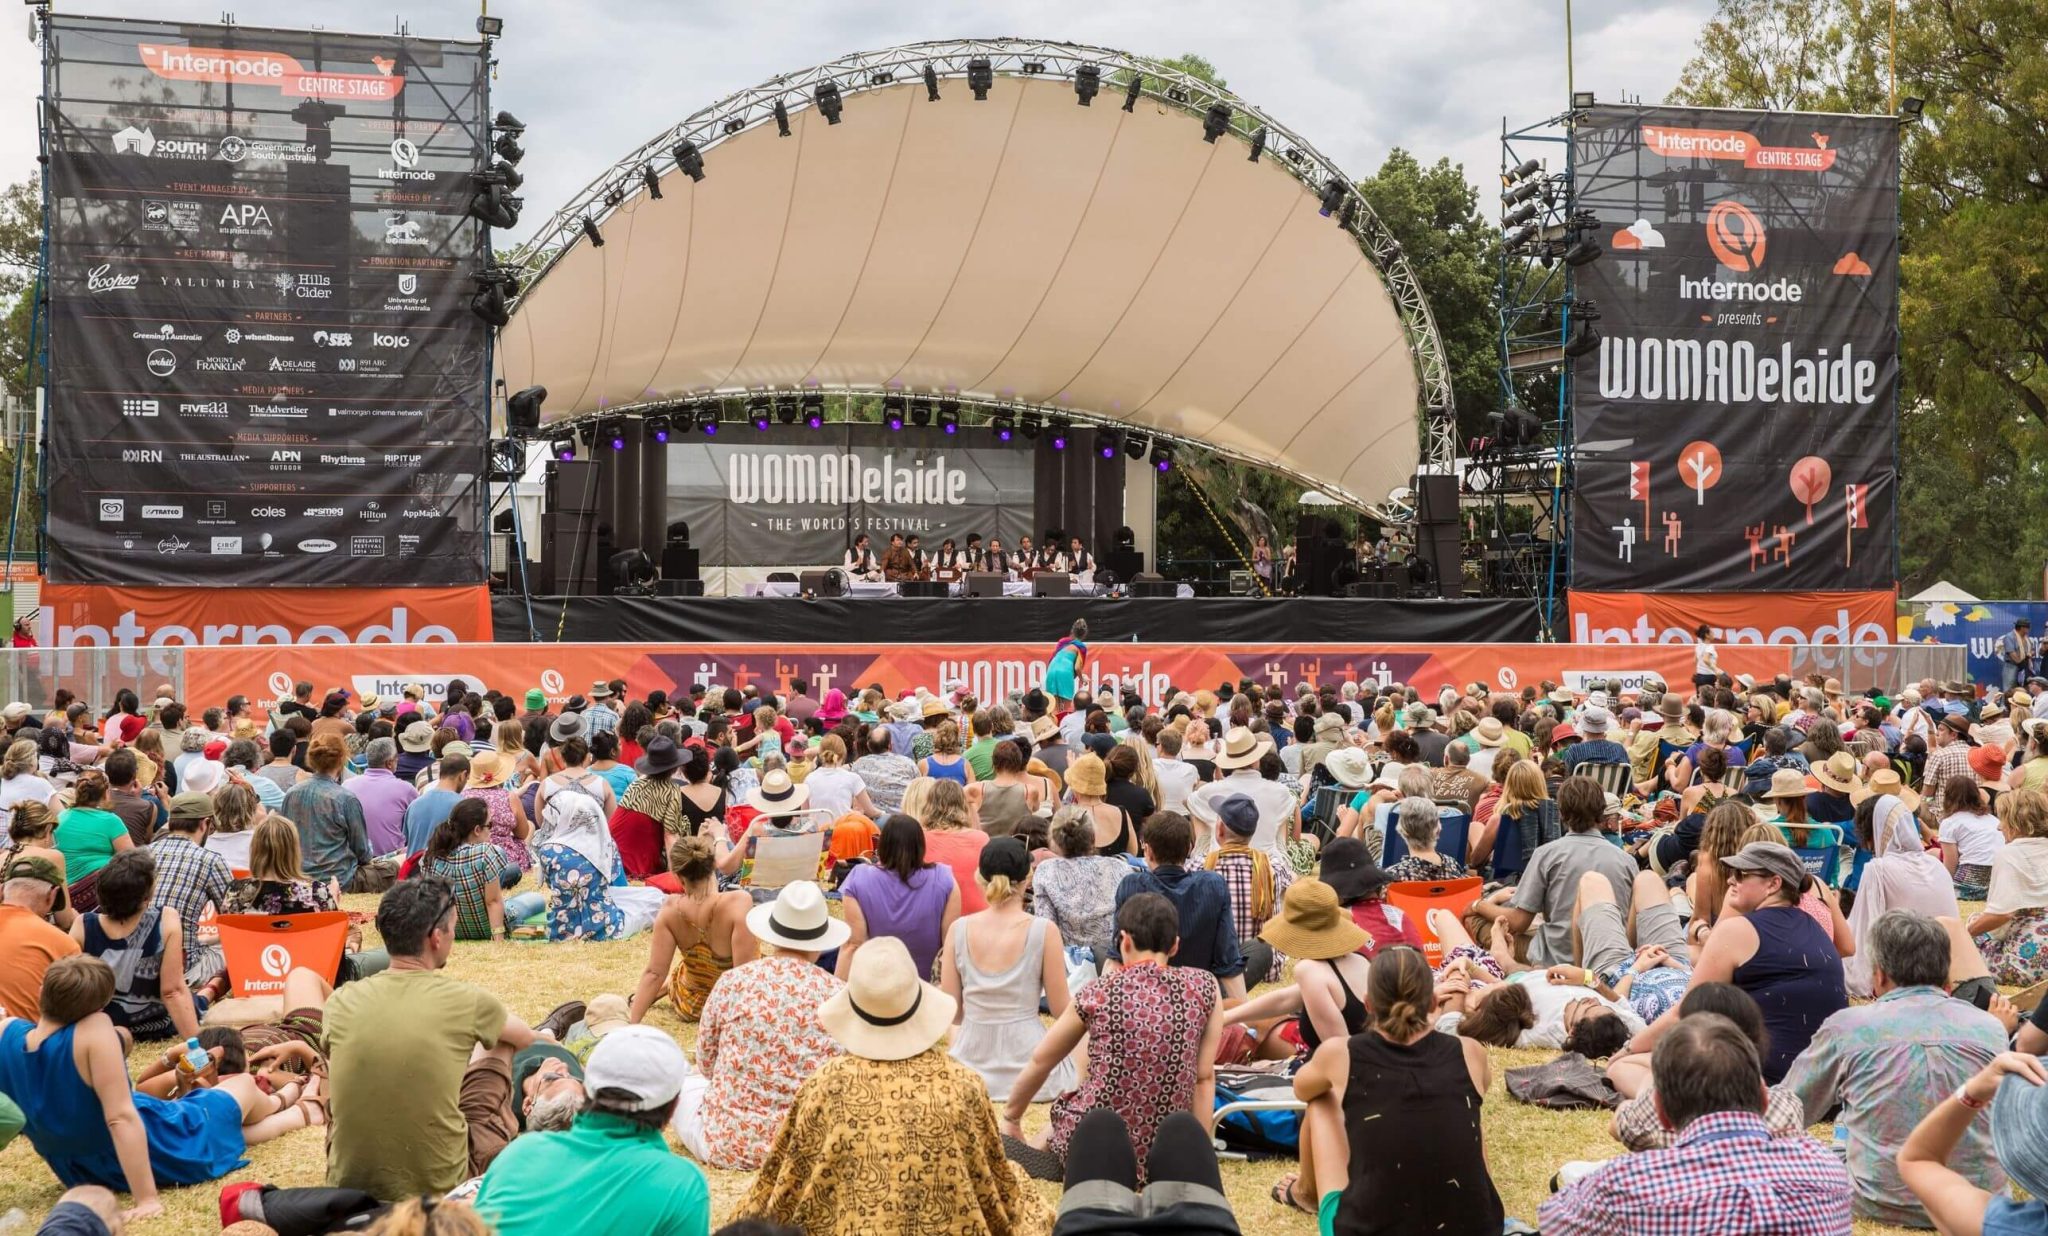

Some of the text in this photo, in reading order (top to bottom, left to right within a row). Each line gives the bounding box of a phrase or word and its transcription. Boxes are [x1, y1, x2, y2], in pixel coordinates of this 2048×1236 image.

[162, 50, 284, 78] Internode
[298, 76, 386, 96] CENTRE STAGE
[157, 140, 207, 155] SOUTH
[251, 142, 306, 154] Government
[307, 143, 317, 154] of
[1658, 131, 1746, 153] Internode
[157, 153, 207, 161] AUSTRALIA
[251, 151, 317, 163] South Australia
[1756, 150, 1823, 168] CENTRE STAGE
[378, 168, 436, 181] Internode
[174, 182, 248, 194] EVENT MANAGED BY
[382, 193, 432, 203] PRODUCED BY
[172, 202, 199, 210] WOMAD
[219, 203, 272, 227] APA
[184, 249, 198, 258] KEY
[370, 256, 409, 266] EDUCATION
[88, 264, 140, 293] Coopers
[161, 276, 255, 290] YALUMBA
[299, 274, 331, 286] Hills
[296, 287, 332, 299] Cider
[1680, 275, 1802, 302] Internode
[388, 297, 419, 305] University
[404, 304, 431, 312] Australia
[255, 312, 293, 321] PARTNERS
[1717, 312, 1762, 327] presents
[133, 332, 165, 341] Greening
[245, 334, 294, 342] wheelhouse
[196, 360, 242, 371] FRANKLIN
[268, 356, 316, 372] ADELAIDE
[373, 359, 387, 367] ABC
[1600, 336, 1876, 405] WOMADelaide
[242, 385, 305, 396] MEDIA PARTNERS
[142, 400, 159, 417] 9
[180, 402, 229, 414] FIVEaa
[249, 404, 309, 415] The Advertiser
[237, 432, 309, 443] MEDIA SUPPORTERS
[140, 450, 163, 463] RN
[180, 453, 245, 462] THE AUSTRALIAN
[271, 450, 301, 462] APN
[320, 454, 366, 465] Rhythms
[384, 454, 399, 462] RIP
[409, 455, 422, 463] UP
[729, 453, 967, 505] WOMADelaide
[250, 483, 296, 492] SUPPORTERS
[251, 506, 286, 518] coles
[318, 507, 344, 516] smeg
[359, 510, 387, 519] Hilton
[402, 506, 441, 519] AppMajik
[767, 517, 931, 532] THE WORLD'S FESTIVAL
[1575, 608, 1889, 669] Itode
[376, 679, 468, 696] Intno
[939, 660, 1171, 708] WOMAlaide
[244, 979, 287, 991] Intern
